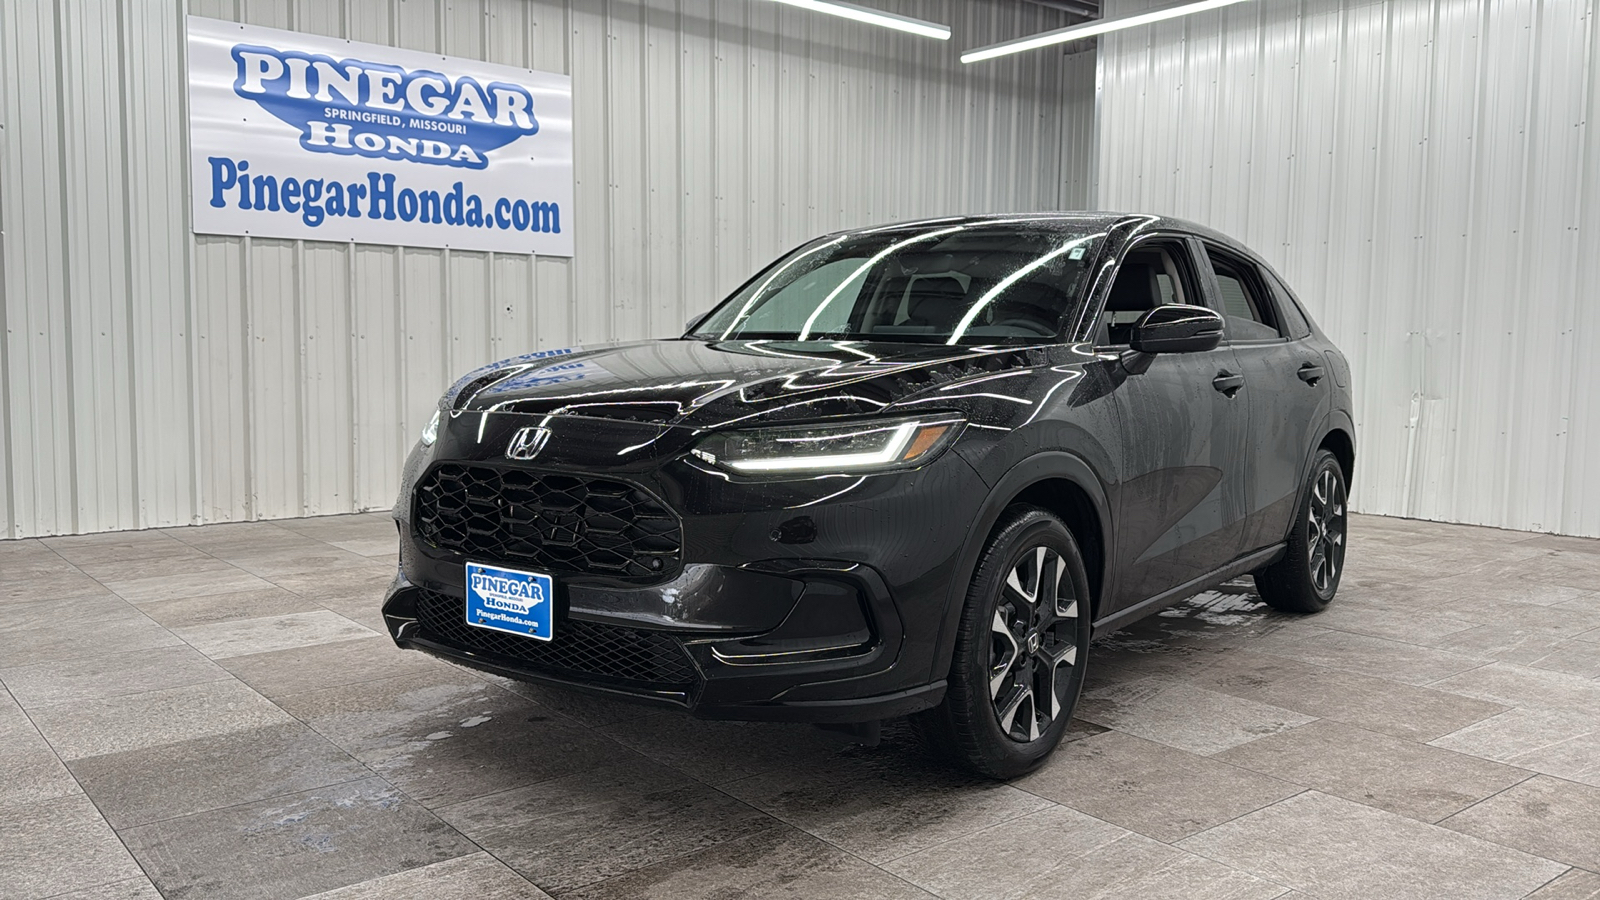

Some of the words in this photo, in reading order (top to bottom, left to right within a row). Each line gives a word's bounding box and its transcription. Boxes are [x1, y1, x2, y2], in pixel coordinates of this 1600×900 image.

[239, 51, 535, 130] PINEGAR
[324, 107, 406, 128] SPRINGFIELD,
[409, 118, 467, 135] MISSOURI
[306, 120, 483, 164] HONDA
[207, 156, 561, 234] PinegarHonda.com
[472, 575, 542, 600] PINEGAR
[476, 608, 539, 627] PinegarHonda.com
[485, 597, 527, 612] HONDA
